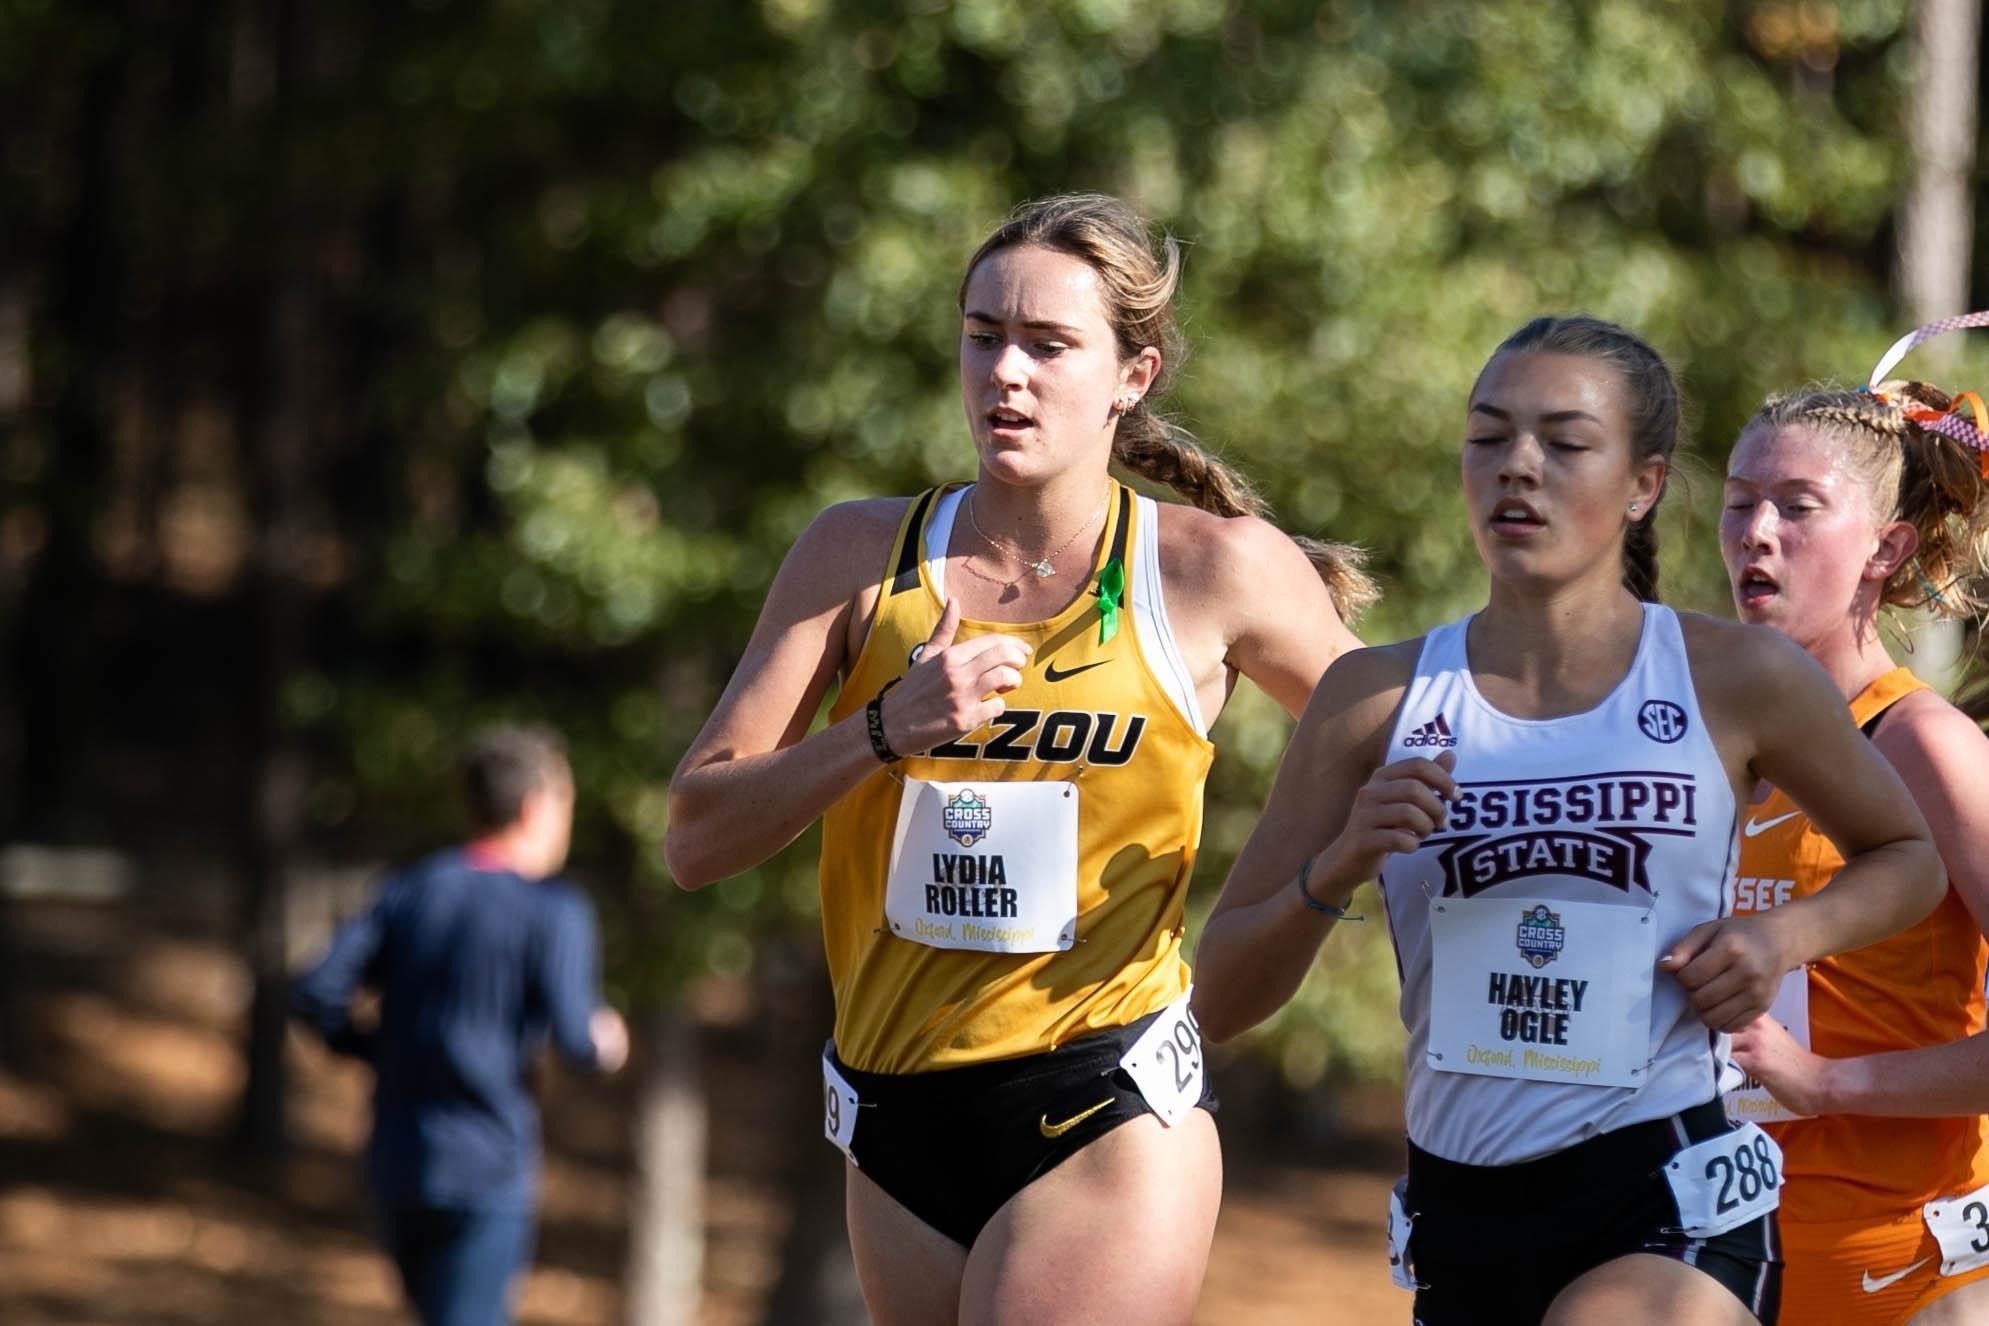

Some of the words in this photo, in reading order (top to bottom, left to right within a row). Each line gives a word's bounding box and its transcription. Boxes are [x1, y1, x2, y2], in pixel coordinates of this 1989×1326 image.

[1641, 702, 1684, 741] SEC
[1403, 734, 1458, 748] adidas
[945, 808, 990, 820] CROSS
[1433, 781, 1697, 833] SSISSIPPI
[945, 820, 990, 829] COUNTRY
[932, 853, 1007, 885] LYDIA
[1471, 838, 1615, 883] STATE
[925, 884, 1018, 918] ROLLER
[1518, 926, 1563, 941] CROSS
[1518, 938, 1563, 950] COUNTRY
[1488, 972, 1589, 1012] HAYLEY
[1501, 1008, 1569, 1046] OGLE
[1705, 1134, 1778, 1216] 288
